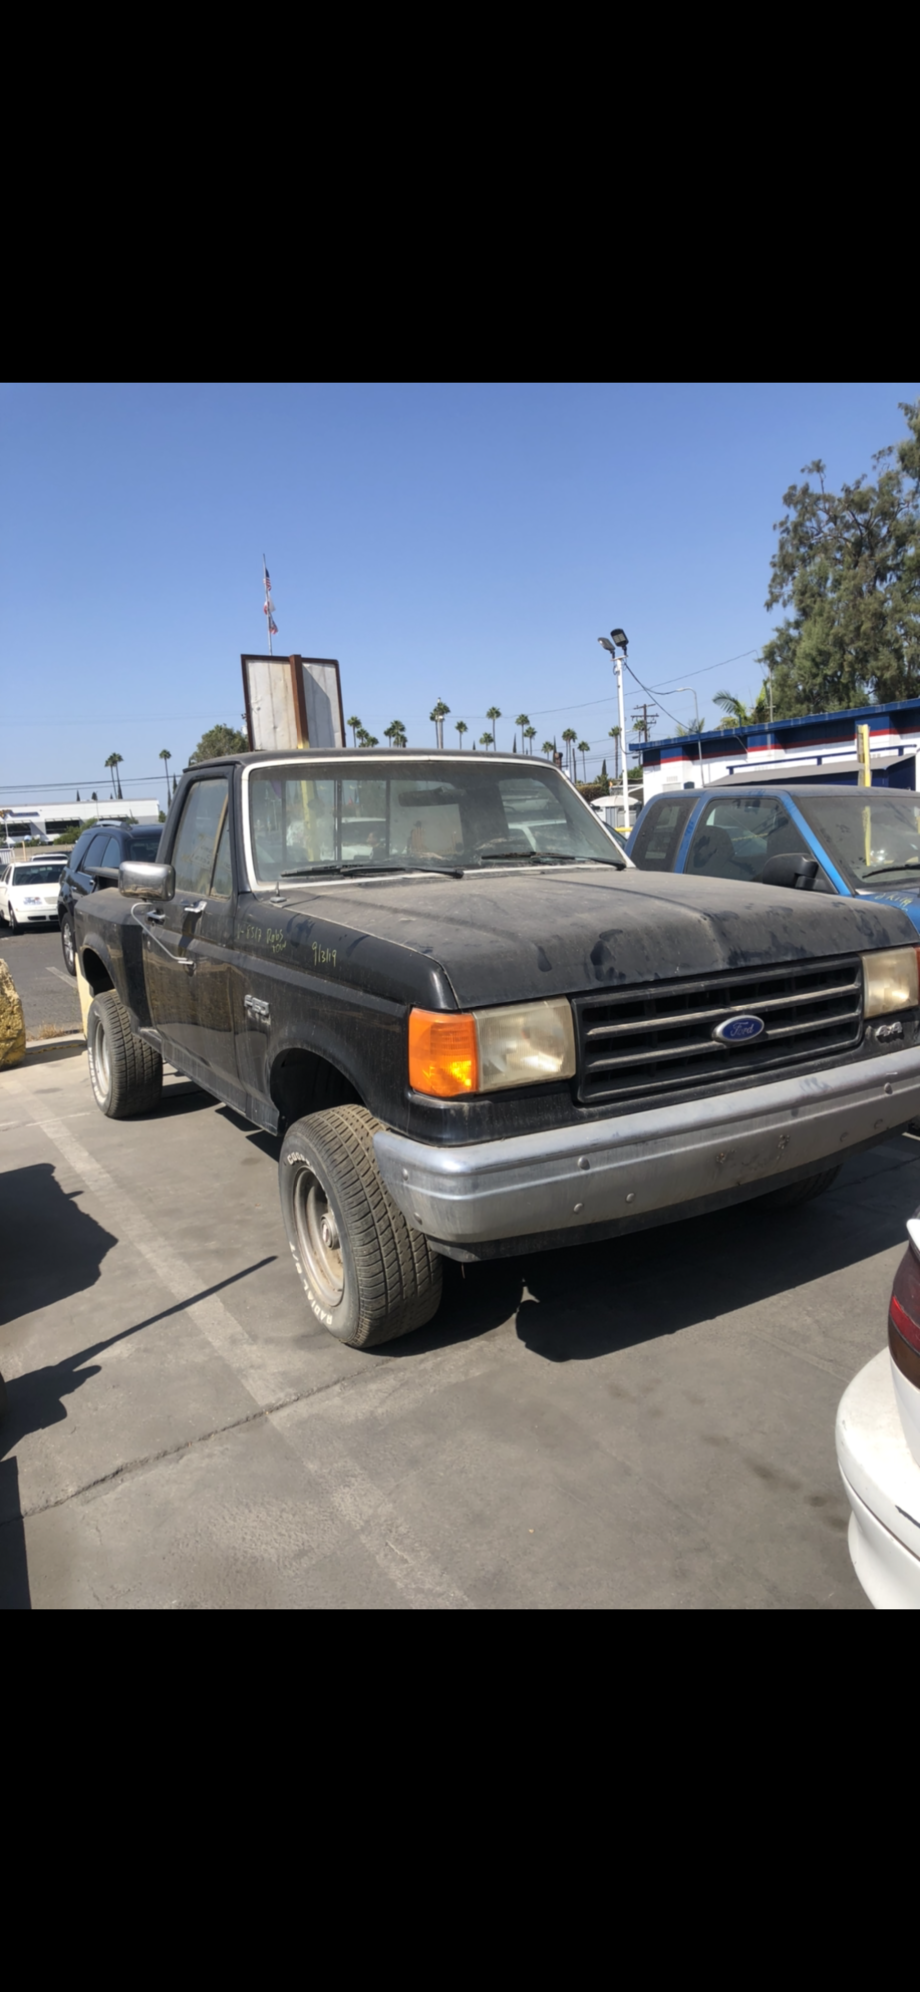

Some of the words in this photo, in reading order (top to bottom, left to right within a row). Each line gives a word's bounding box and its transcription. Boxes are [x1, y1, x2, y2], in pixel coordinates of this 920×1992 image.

[312, 941, 337, 967] 9/3/19
[730, 1021, 754, 1037] Ford
[303, 1279, 333, 1325] RADIAL
